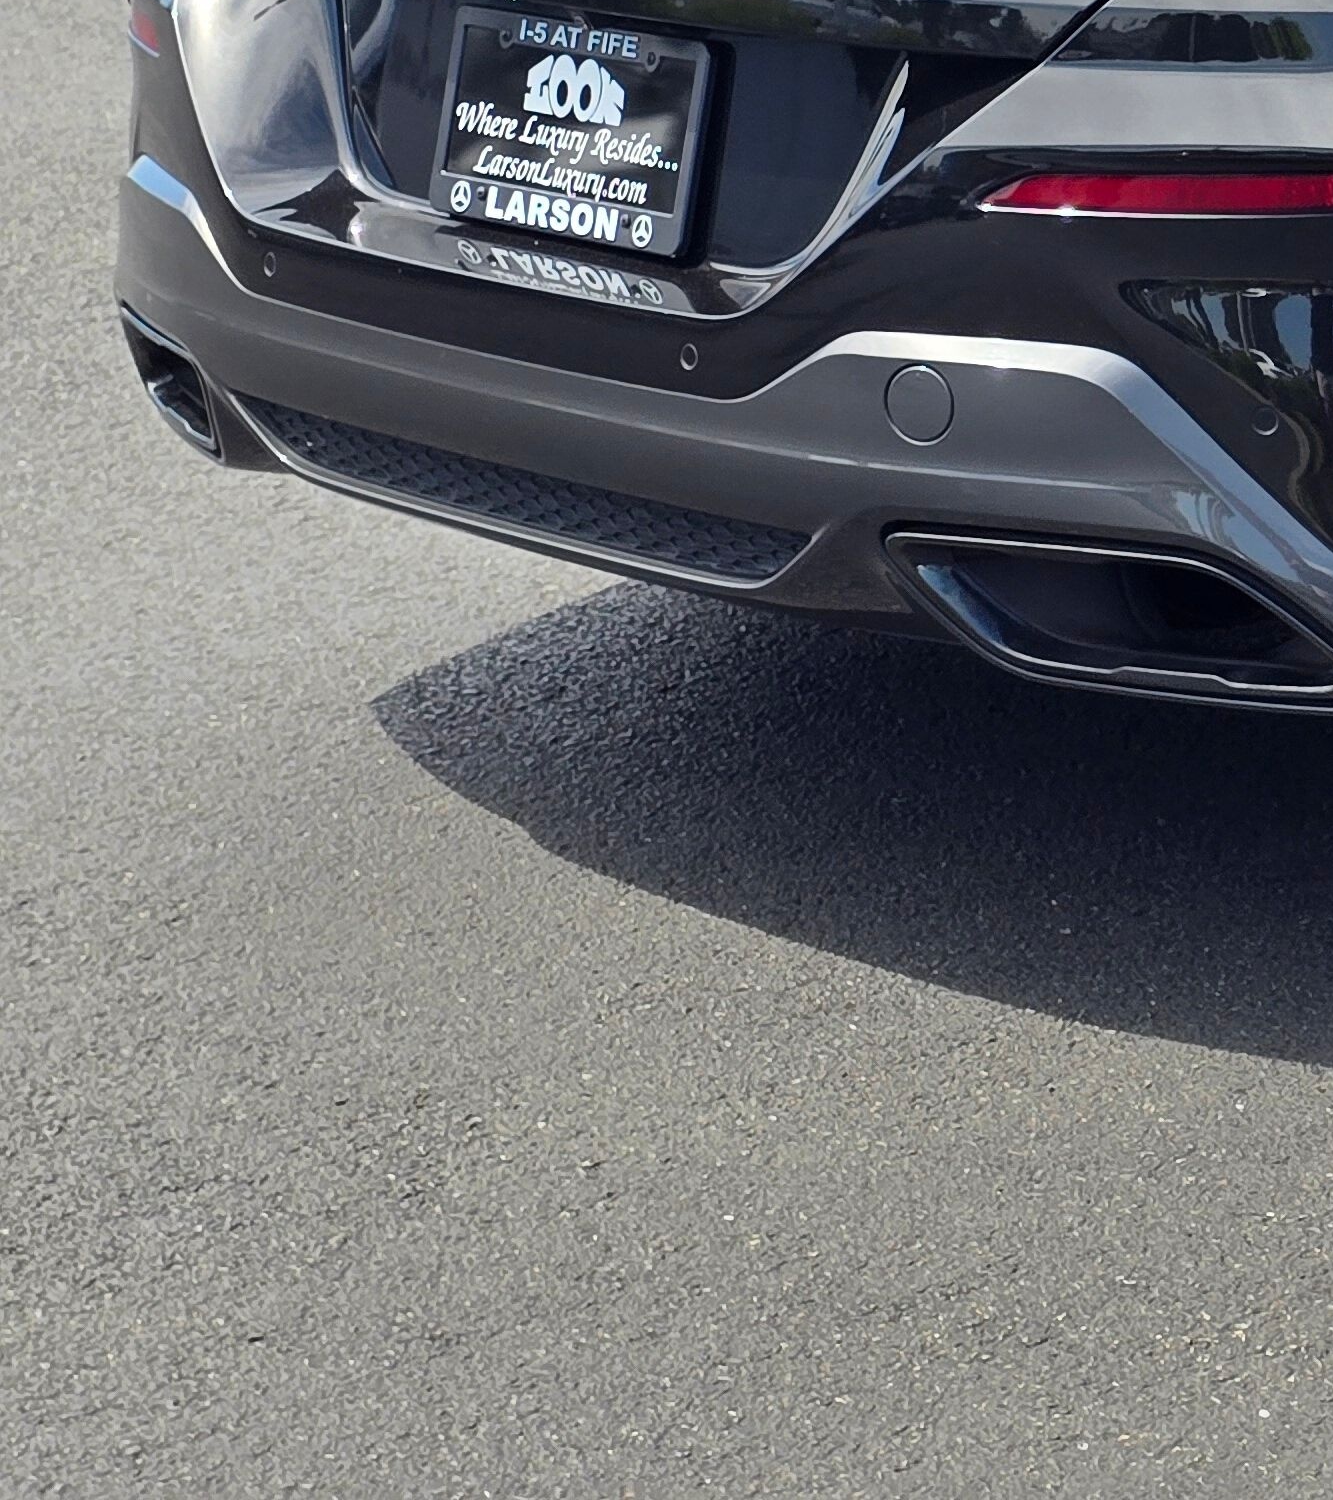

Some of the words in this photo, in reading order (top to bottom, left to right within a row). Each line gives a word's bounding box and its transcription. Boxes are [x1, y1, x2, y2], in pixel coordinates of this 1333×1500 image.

[519, 18, 547, 44] I-5
[550, 24, 583, 49] AT
[587, 30, 639, 59] FIFE
[455, 101, 519, 140] Where
[518, 115, 590, 165] Luxury
[590, 128, 679, 171] Resides...
[472, 145, 648, 205] LarsonLuxury.com
[484, 185, 620, 241] LARSON
